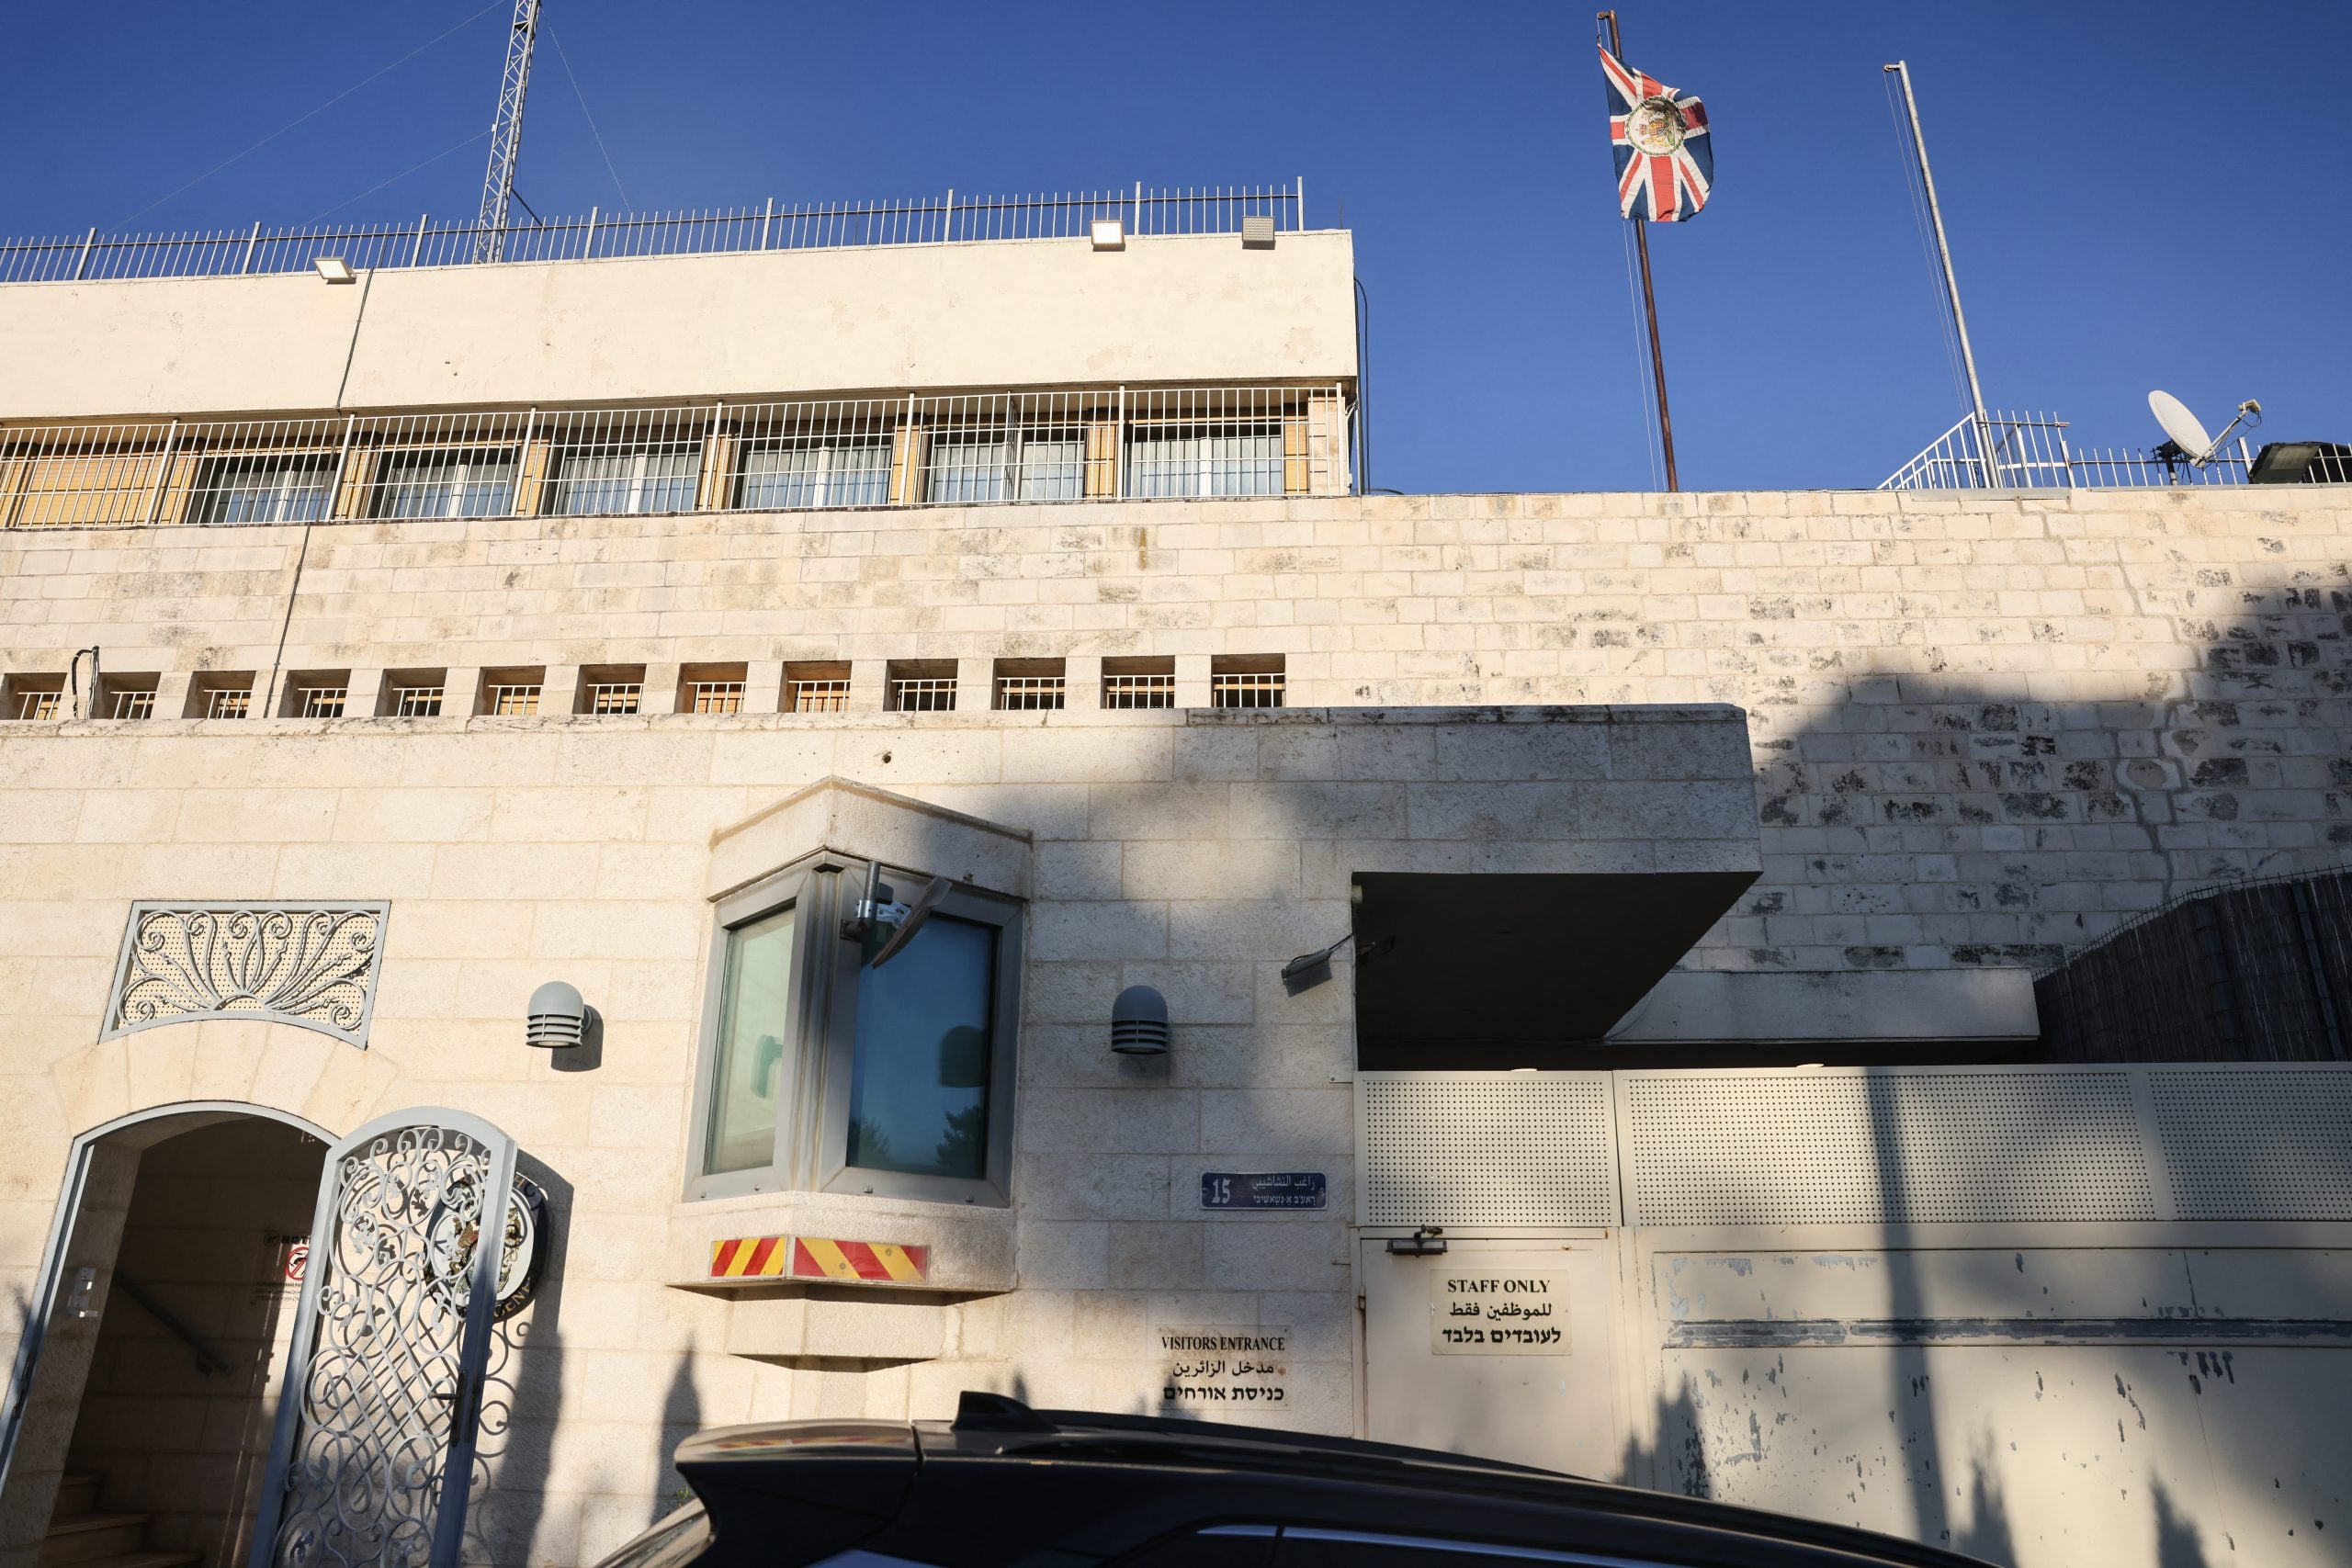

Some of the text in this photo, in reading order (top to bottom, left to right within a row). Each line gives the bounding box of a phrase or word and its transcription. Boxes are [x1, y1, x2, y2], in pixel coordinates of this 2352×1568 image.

[1212, 1178, 1232, 1204] 15
[1252, 1175, 1316, 1191] راغب النشاشيبي
[1447, 1279, 1551, 1293] STAFF ONLY
[1449, 1301, 1553, 1321] للموظفين فقط
[1161, 1336, 1286, 1351] VISITORS ENTRANCE
[1442, 1325, 1562, 1345] לעובדים בלבד
[1172, 1359, 1275, 1378] مدخل الزائرين
[1162, 1386, 1285, 1402] כניסת אורחים
